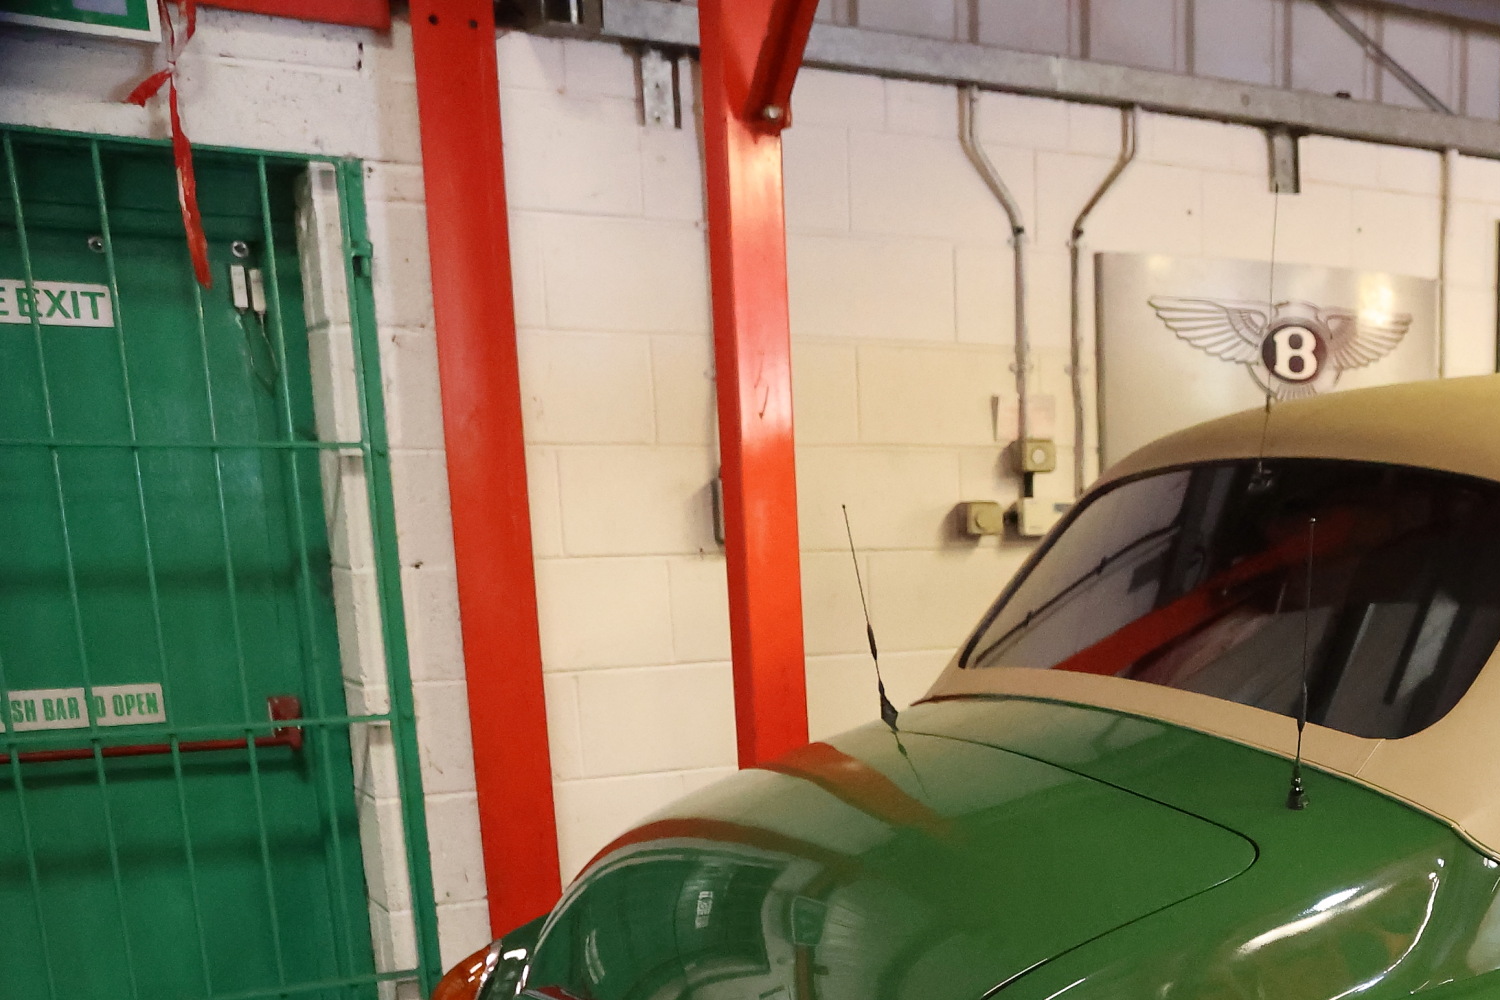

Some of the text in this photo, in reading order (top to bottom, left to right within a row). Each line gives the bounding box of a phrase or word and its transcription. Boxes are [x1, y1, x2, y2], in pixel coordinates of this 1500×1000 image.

[15, 287, 106, 320] EXIT
[1272, 325, 1318, 381] B
[42, 696, 80, 721] BAR
[112, 692, 159, 717] OPEN
